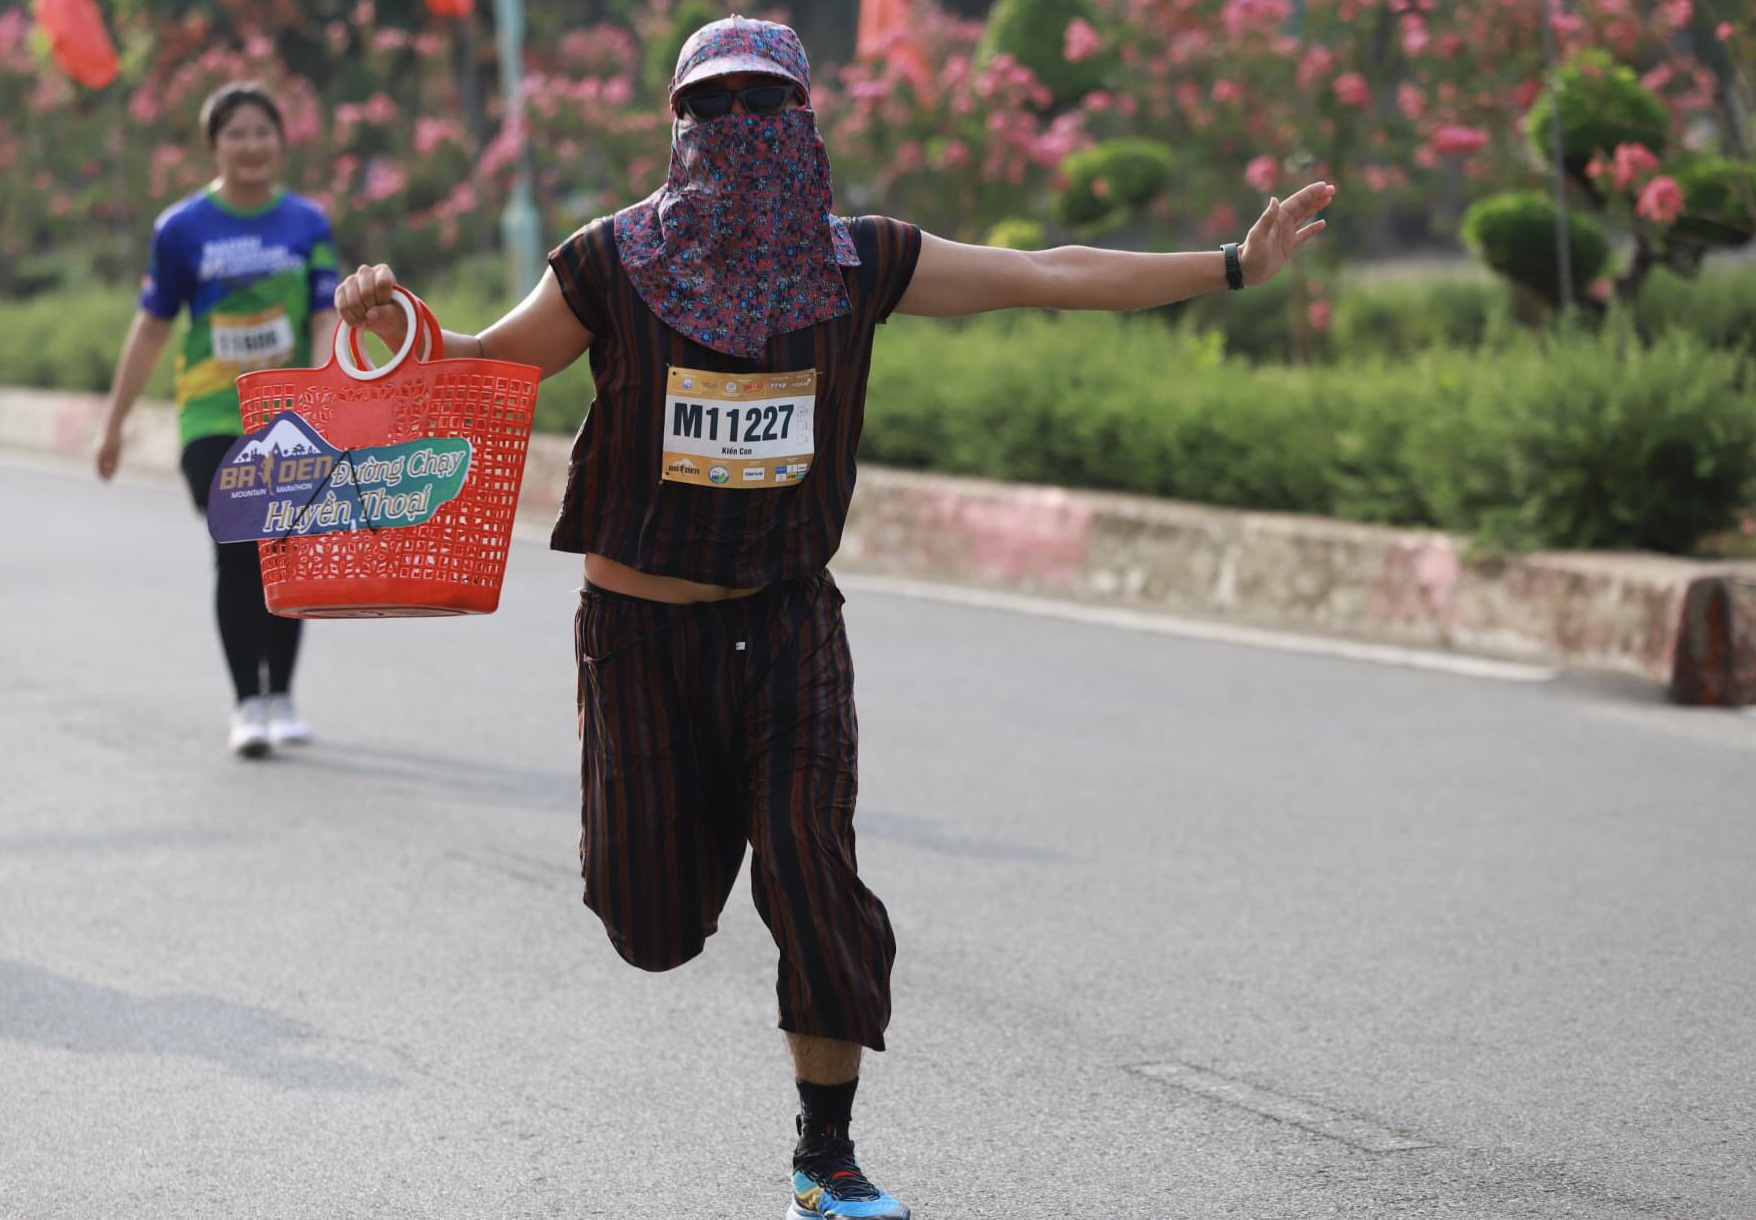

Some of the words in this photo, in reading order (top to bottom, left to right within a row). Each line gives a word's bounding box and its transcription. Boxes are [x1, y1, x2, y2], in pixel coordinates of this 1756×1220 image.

[673, 402, 794, 442] M11227
[330, 455, 406, 487] Đường
[407, 448, 466, 479] Chạy
[739, 447, 752, 455] Con
[219, 465, 256, 490] BA
[278, 455, 333, 483] DEN
[231, 488, 267, 499] MOUNTAIN
[276, 482, 313, 493] MARATHON
[262, 489, 352, 534] Huyền
[358, 483, 433, 521] Thoại
